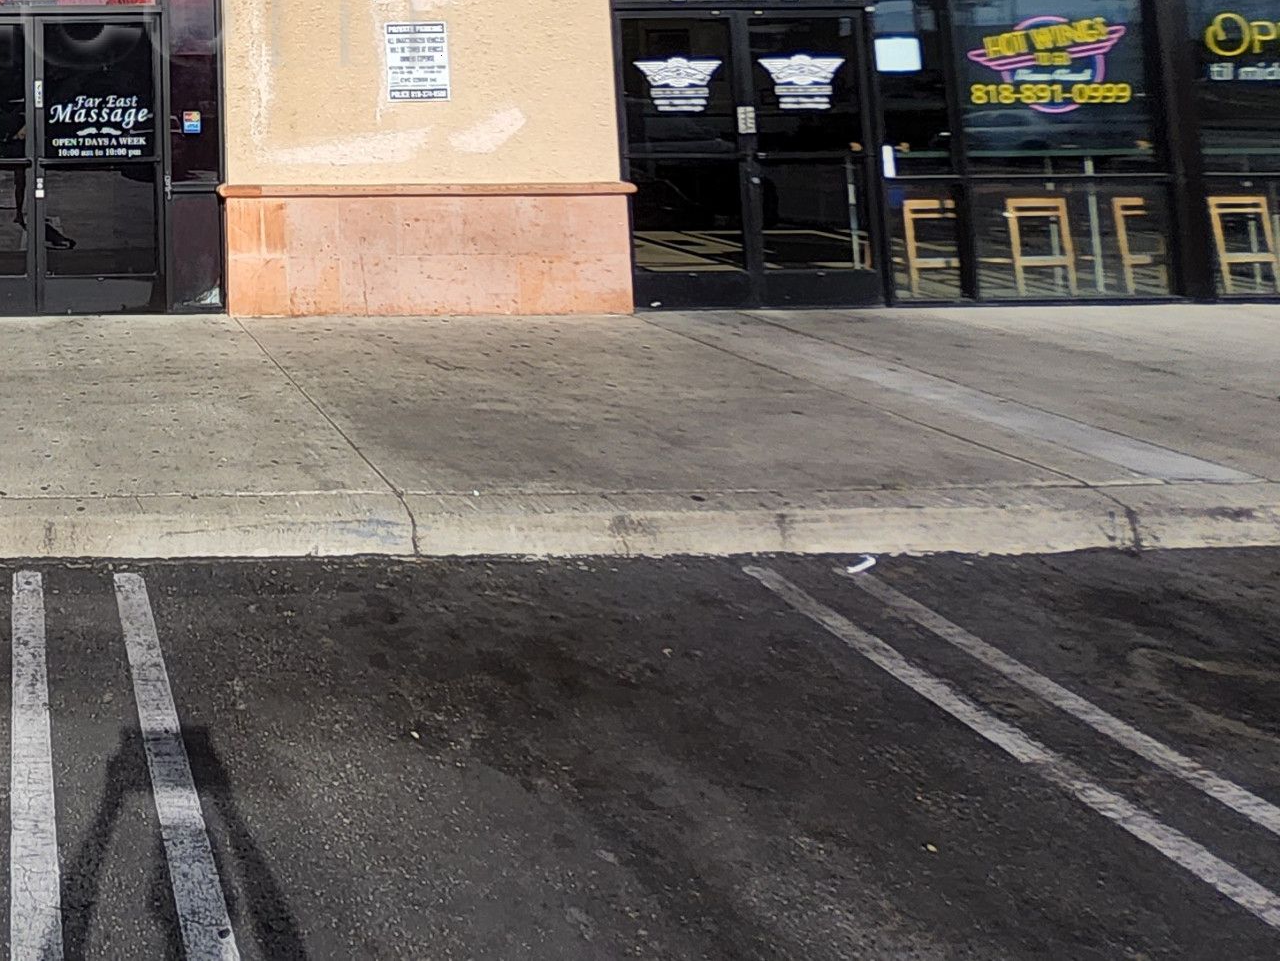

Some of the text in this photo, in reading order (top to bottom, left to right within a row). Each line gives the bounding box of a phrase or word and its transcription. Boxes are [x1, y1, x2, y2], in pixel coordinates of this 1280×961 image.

[983, 30, 1028, 58] HOT
[74, 95, 138, 110] Far East
[970, 83, 1132, 104] 818-891-0999
[49, 104, 150, 129] Massage
[52, 137, 147, 146] OPEN 7 DAYS A WEEK
[58, 148, 80, 156] 10:00
